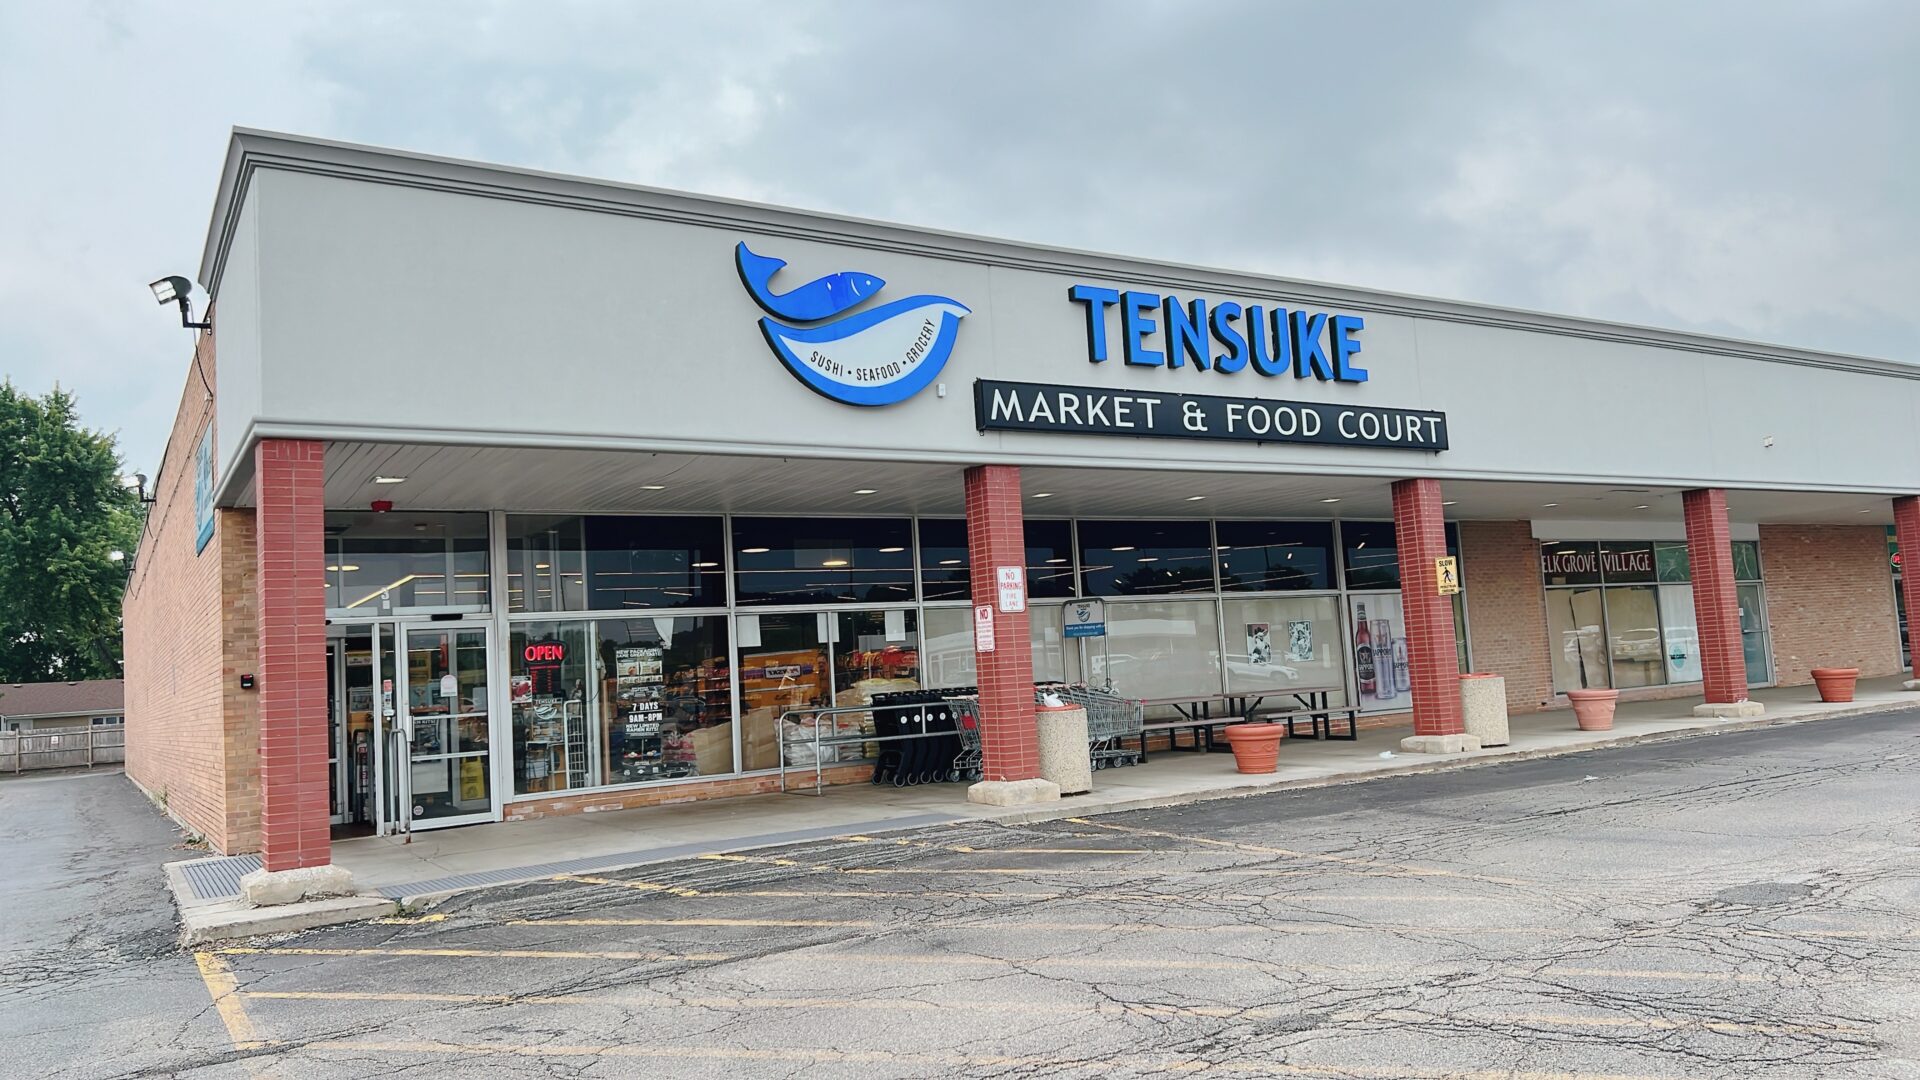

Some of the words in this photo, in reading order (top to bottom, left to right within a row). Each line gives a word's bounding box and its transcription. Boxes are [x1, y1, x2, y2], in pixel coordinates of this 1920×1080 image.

[1068, 285, 1368, 383] TENSUKE
[811, 351, 843, 377] SUSHI
[856, 361, 901, 381] SEAFOOD
[906, 318, 935, 364] GROCERY
[991, 389, 1161, 429] MARKET
[1182, 401, 1208, 431] &
[1226, 404, 1321, 437] FOOD
[1338, 411, 1442, 443] COURT
[1438, 559, 1453, 567] SLOW
[1541, 555, 1562, 573] ELK
[1562, 554, 1598, 573] GROVE
[1602, 554, 1652, 572] VILLAGE
[1005, 572, 1015, 580] NO
[1000, 582, 1022, 590] PARKING
[979, 609, 989, 620] NO
[525, 645, 564, 661] OPEN
[632, 703, 637, 711] 7
[639, 701, 659, 711] DAYS
[628, 712, 663, 723] 9AM-8PM
